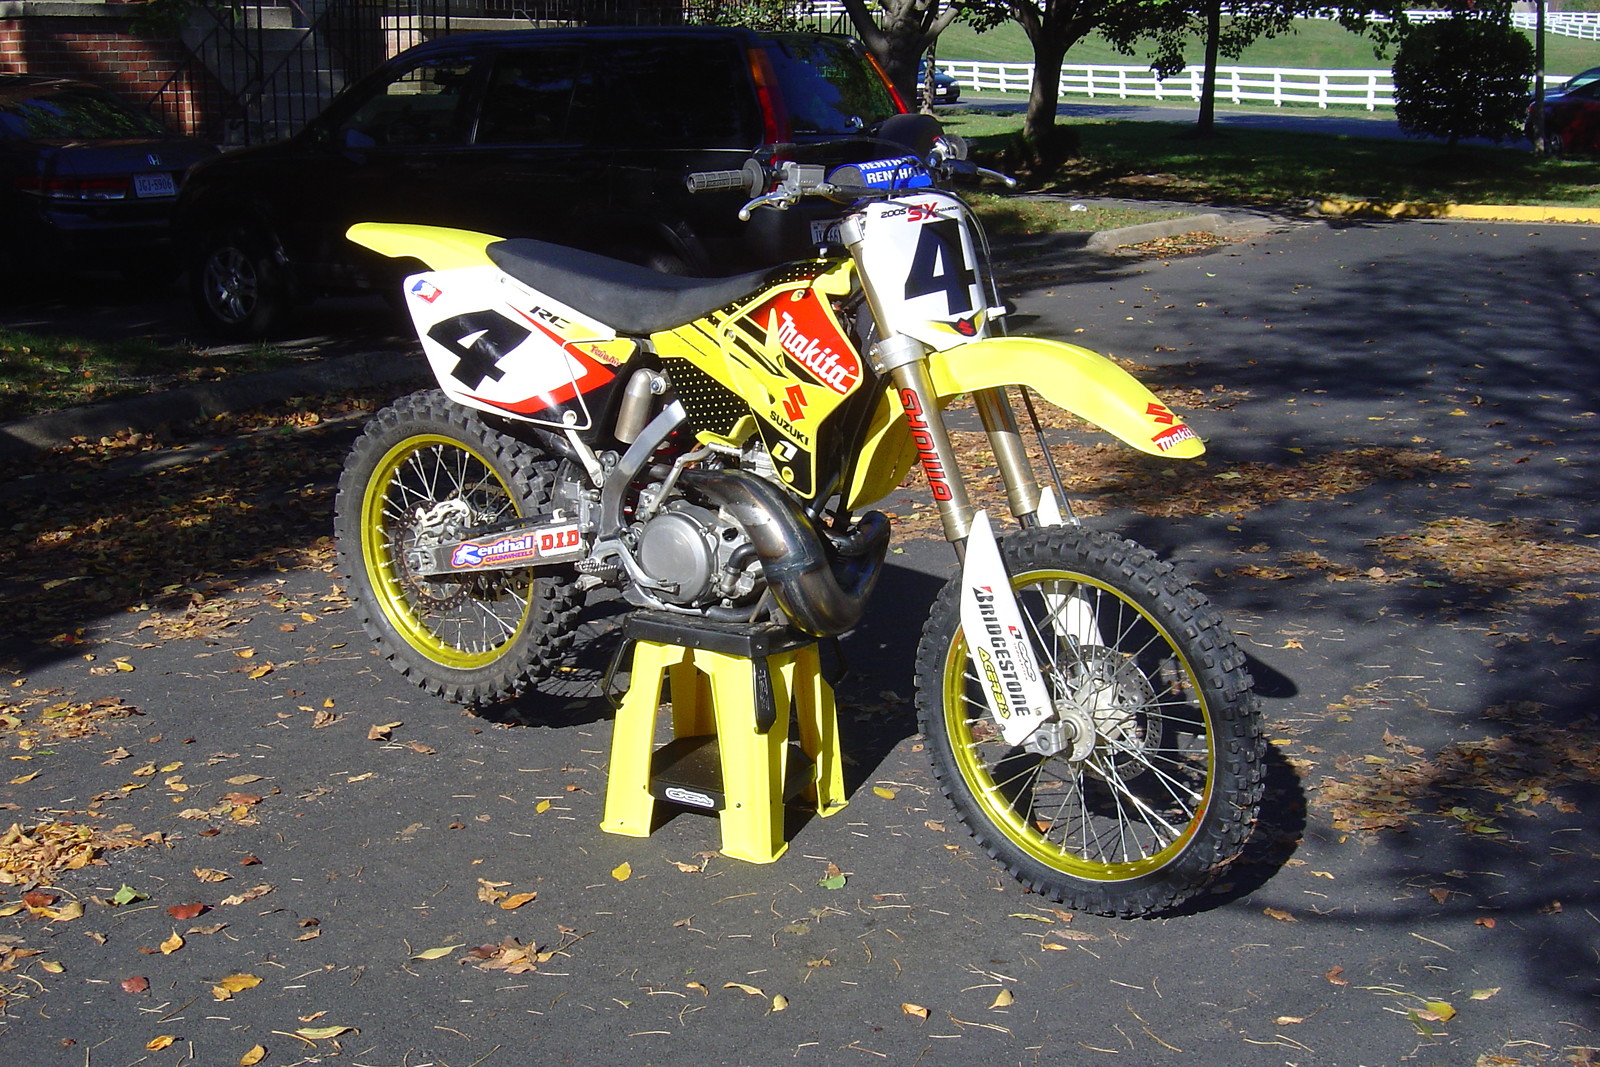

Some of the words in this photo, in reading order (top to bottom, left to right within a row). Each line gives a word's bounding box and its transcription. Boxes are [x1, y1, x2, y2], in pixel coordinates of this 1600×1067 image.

[859, 157, 912, 170] RENTH
[907, 202, 939, 222] SX
[905, 218, 977, 316] 4
[529, 305, 571, 330] RC
[427, 309, 532, 391] 4
[769, 410, 810, 446] SUZUKI
[901, 388, 953, 501] SHOWA
[454, 536, 534, 566] Renthal
[972, 586, 1031, 717] BRIDGESTONE
